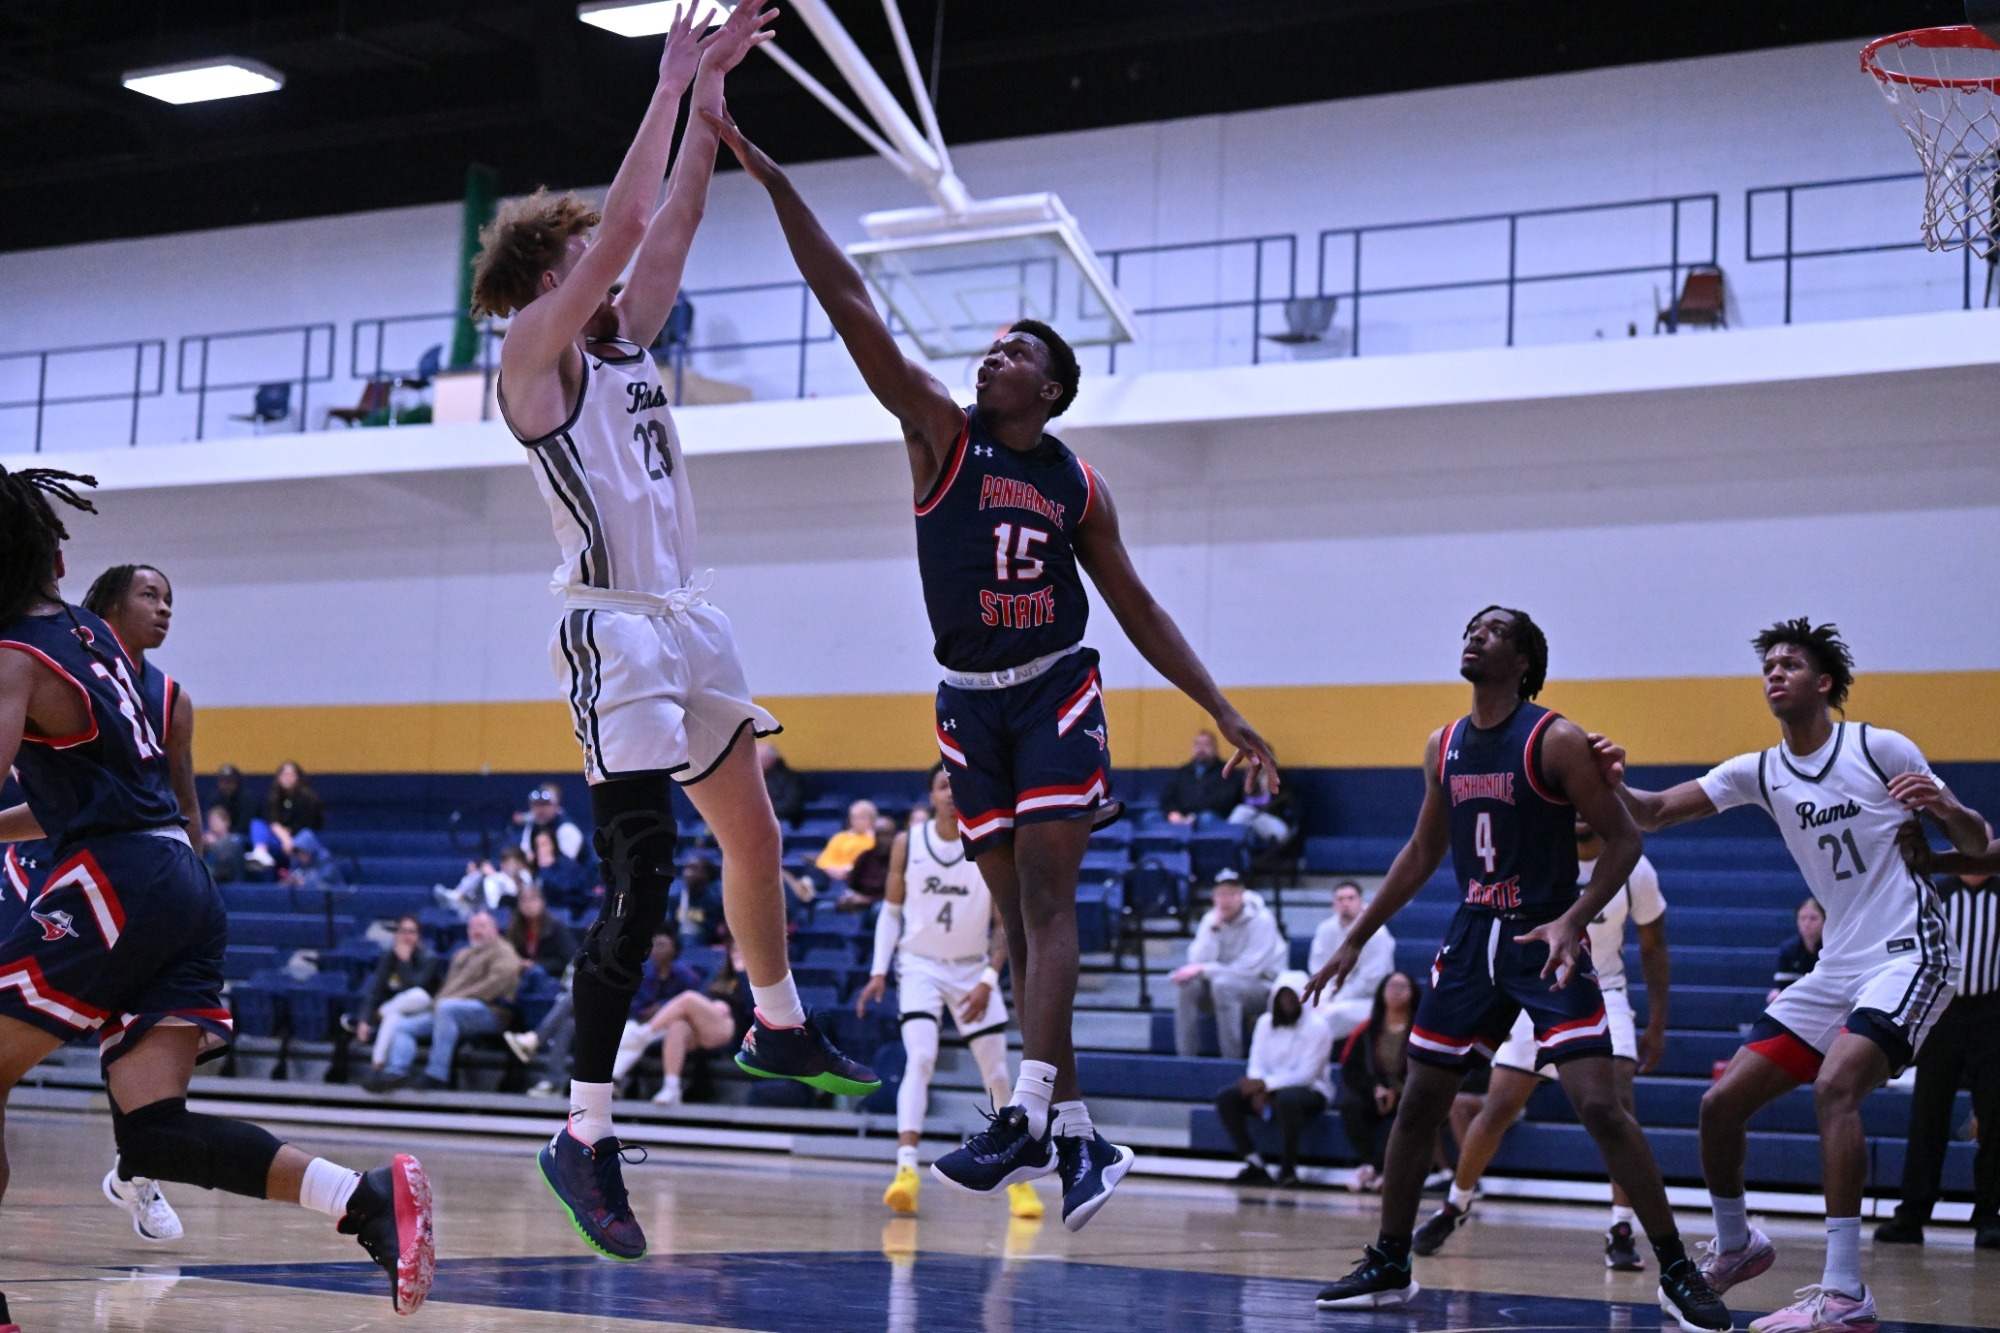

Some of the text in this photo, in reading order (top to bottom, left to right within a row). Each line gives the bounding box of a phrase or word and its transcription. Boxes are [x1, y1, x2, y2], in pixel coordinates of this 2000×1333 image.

[626, 381, 668, 415] Rs
[633, 419, 674, 481] 23
[992, 522, 1049, 581] 15
[979, 584, 1055, 629] STATE
[1449, 772, 1516, 808] PANHANDLE
[1795, 799, 1861, 830] Rams
[1474, 811, 1497, 875] 4
[1817, 828, 1867, 881] 21
[922, 876, 969, 896] Rams
[936, 901, 952, 933] 4
